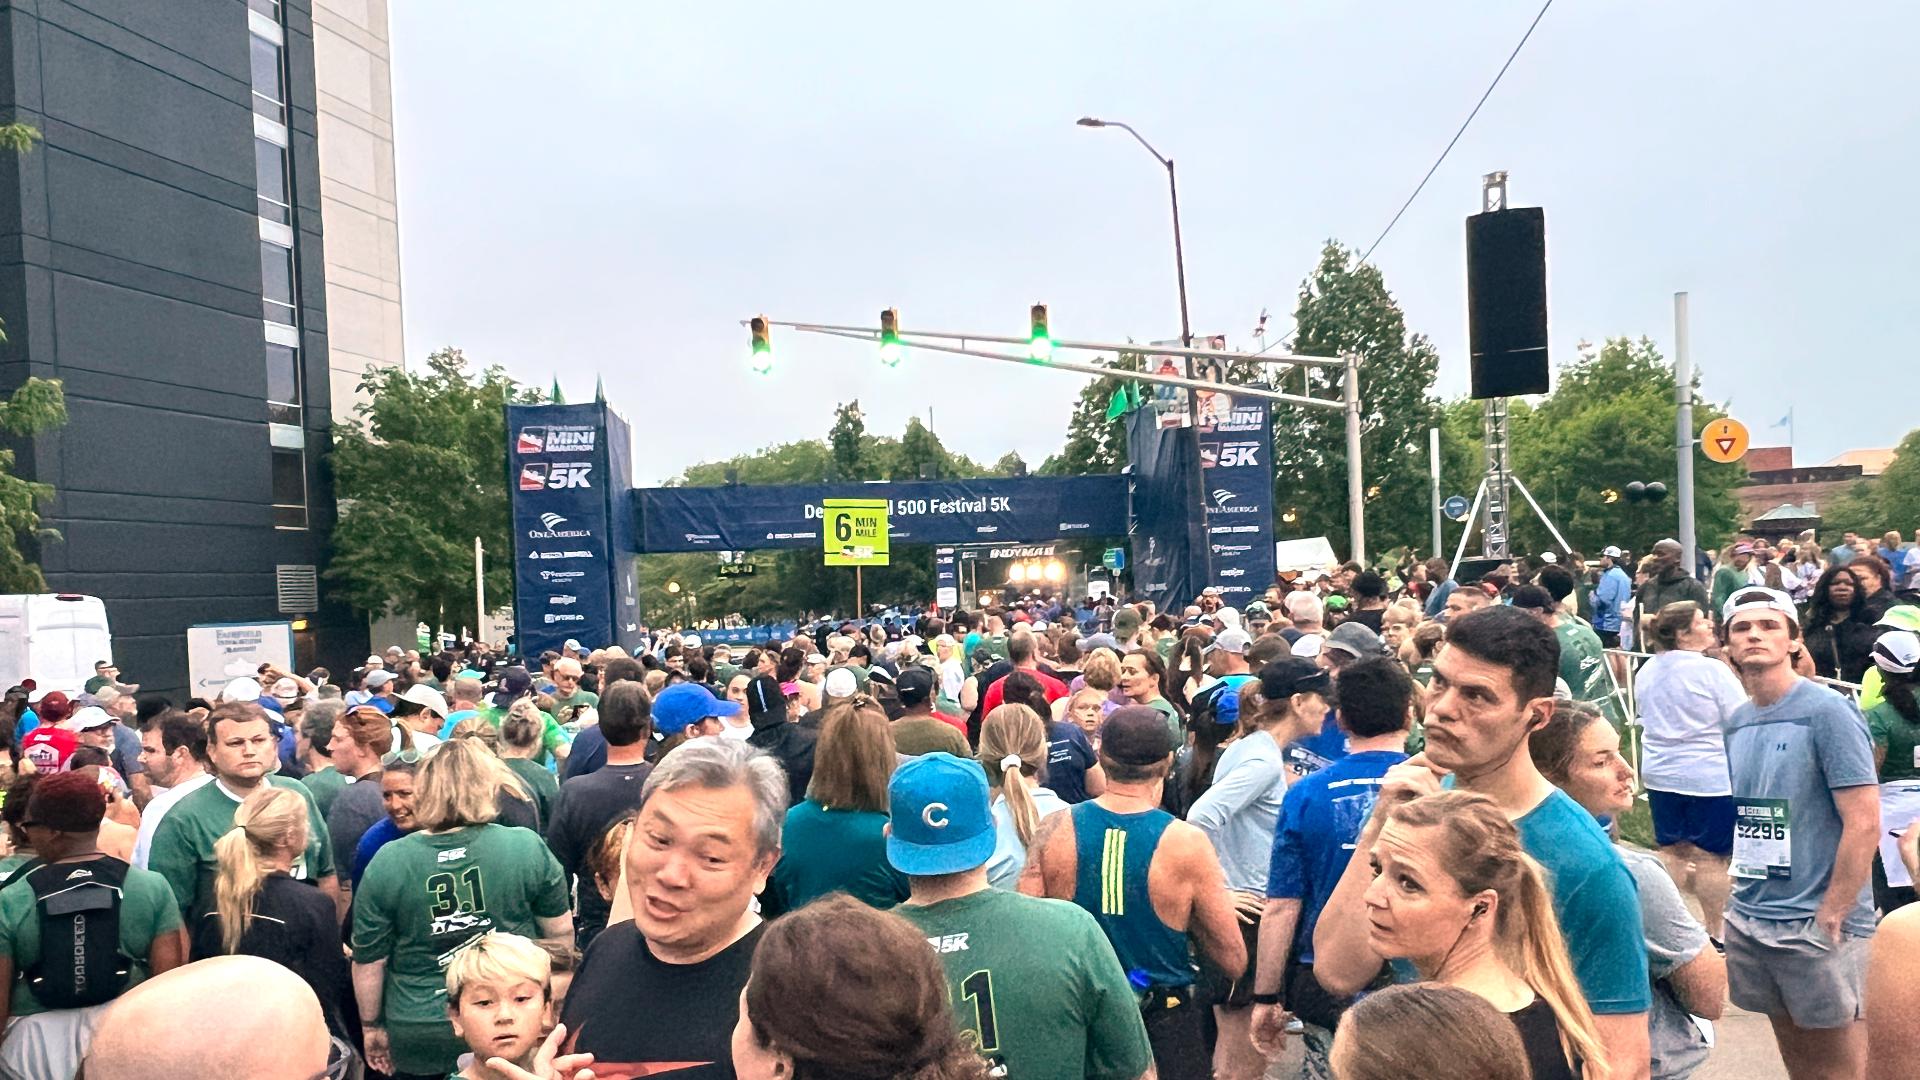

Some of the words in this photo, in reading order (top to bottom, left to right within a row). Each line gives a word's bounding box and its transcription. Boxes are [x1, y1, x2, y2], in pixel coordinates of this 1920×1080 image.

[547, 431, 595, 444] MINI
[1219, 447, 1260, 467] 5K
[548, 468, 592, 489] 5K
[898, 500, 926, 515] 500
[931, 497, 986, 513] Festival
[991, 497, 1011, 512] 5K
[835, 513, 852, 541] 6
[856, 517, 877, 527] MIN
[856, 528, 877, 537] MILE
[922, 803, 949, 828] C
[941, 935, 969, 953] 5K
